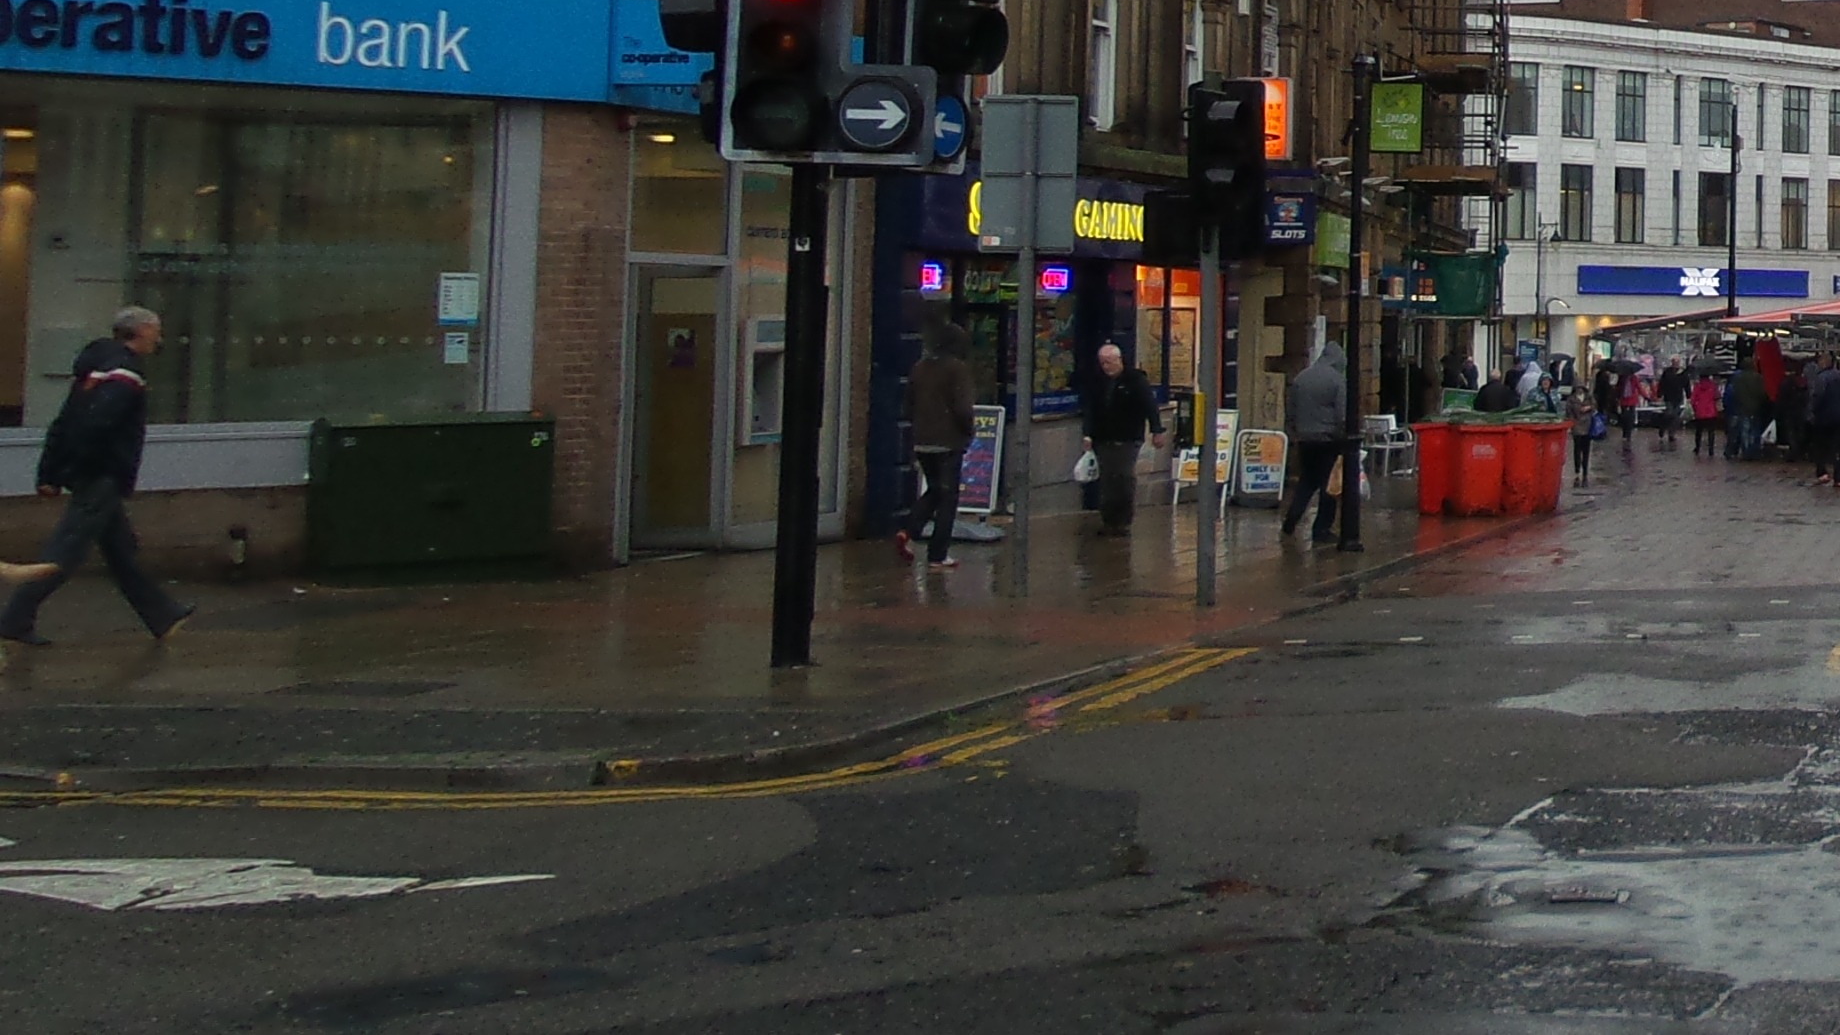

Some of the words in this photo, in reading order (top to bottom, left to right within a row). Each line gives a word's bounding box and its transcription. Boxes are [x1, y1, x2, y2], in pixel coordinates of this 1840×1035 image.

[317, 0, 472, 73] bank
[1271, 229, 1307, 239] SLOTS
[1680, 277, 1720, 287] HALIFAX
